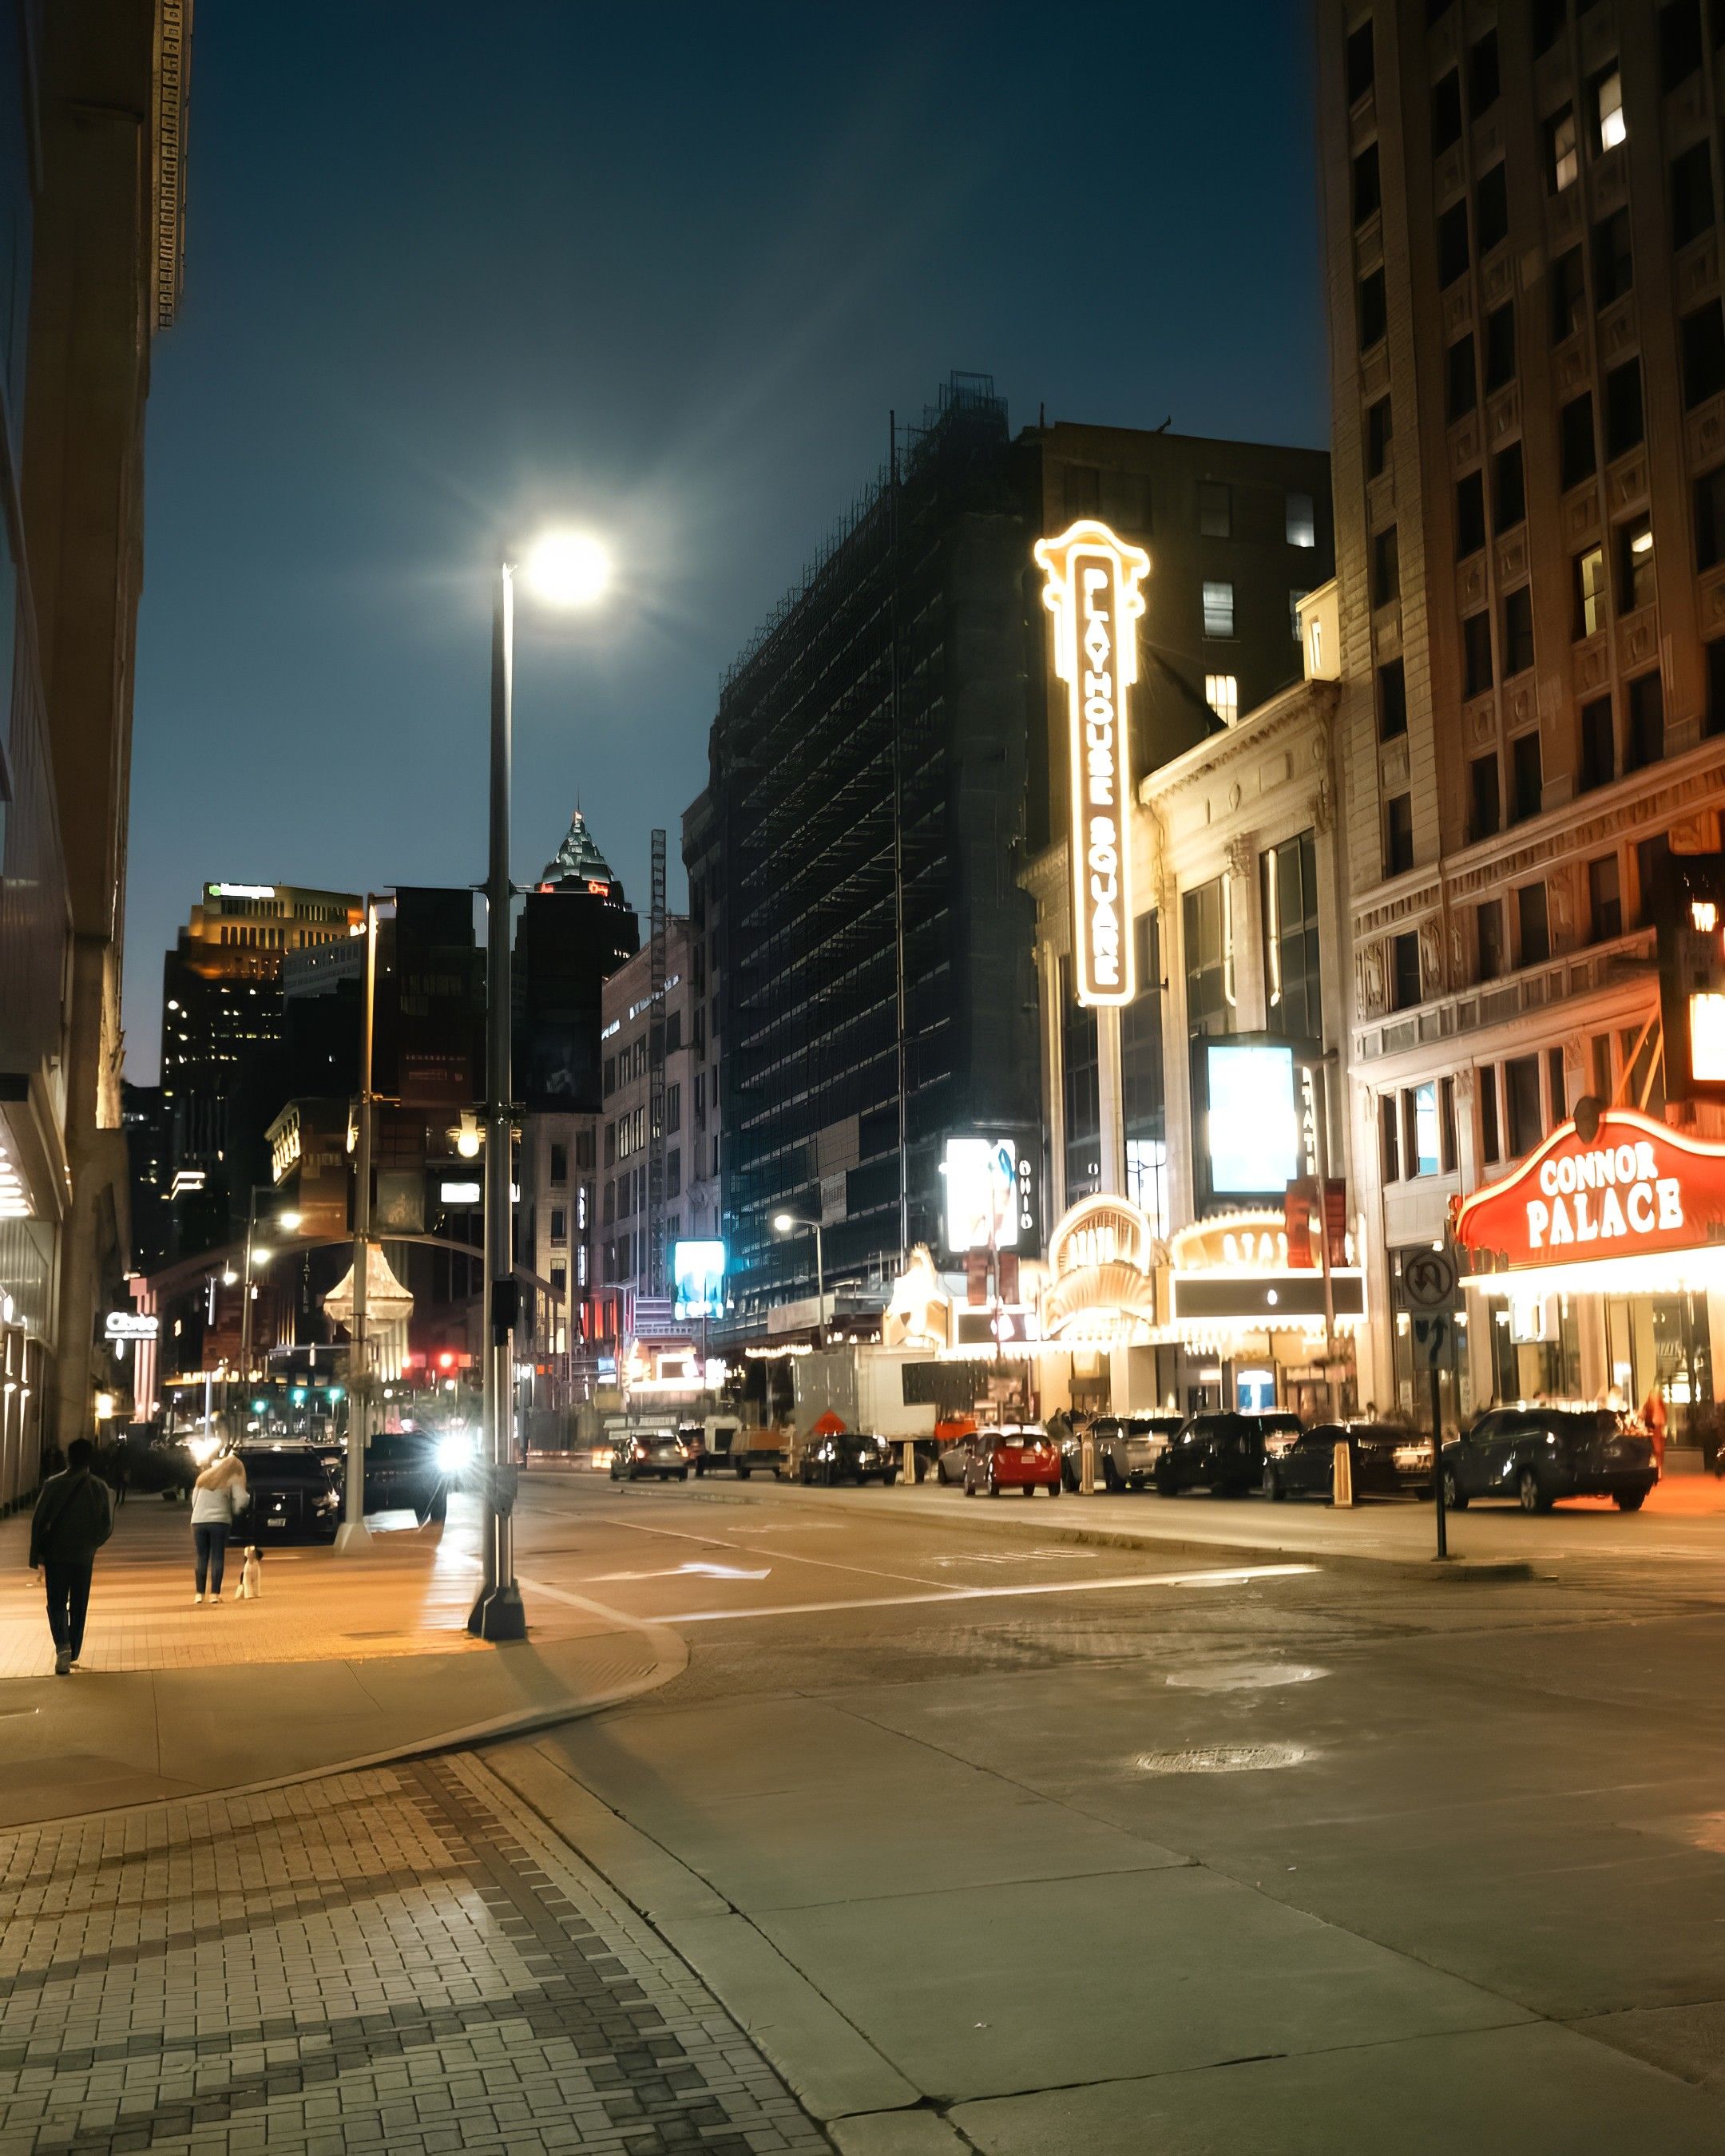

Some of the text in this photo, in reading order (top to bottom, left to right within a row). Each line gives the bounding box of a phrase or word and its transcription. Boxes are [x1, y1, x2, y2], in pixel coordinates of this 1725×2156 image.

[1084, 568, 1120, 985] PLAYHOUSE SQUARE
[1018, 1159, 1033, 1230] OHIO
[1540, 1141, 1659, 1196] CONNOR
[1526, 1178, 1684, 1248] PALACE
